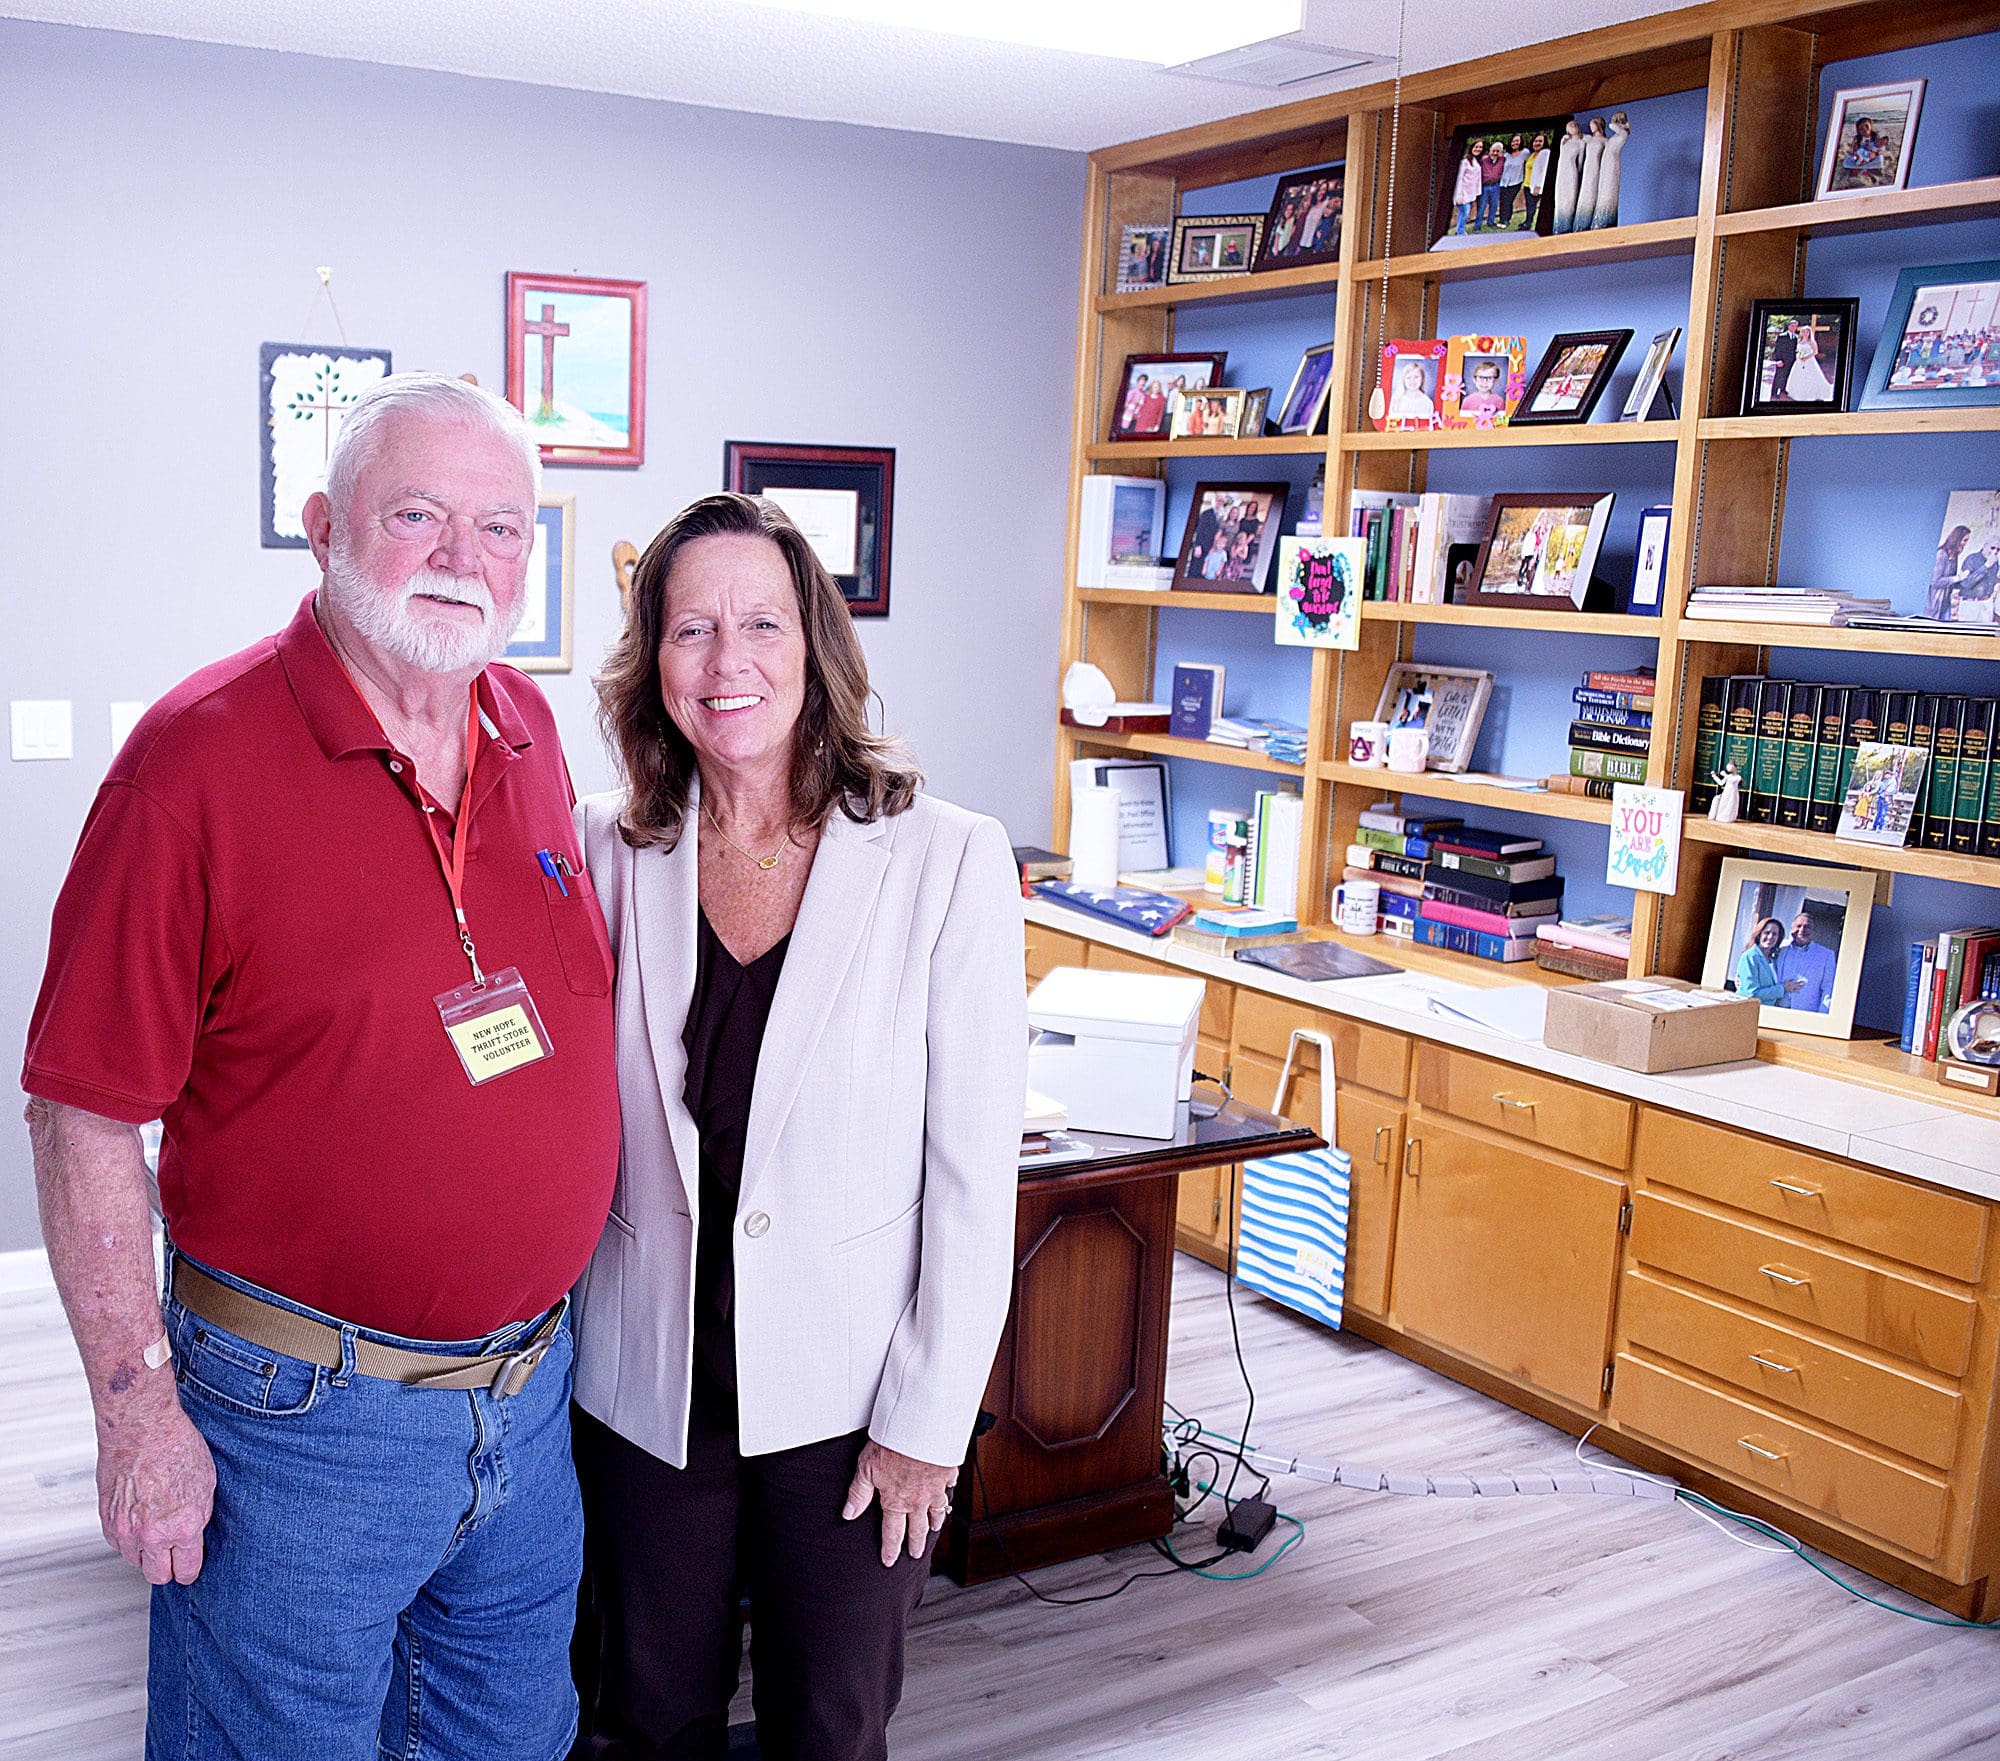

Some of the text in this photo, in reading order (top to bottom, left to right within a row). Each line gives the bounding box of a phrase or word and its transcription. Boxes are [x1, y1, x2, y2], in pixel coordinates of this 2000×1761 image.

[1582, 712, 1627, 725] DICTIONARY
[1592, 730, 1611, 743] Bible
[1612, 732, 1650, 750] Dictionary
[1607, 760, 1642, 775] BIBLE
[1621, 808, 1663, 836] YOU
[1630, 836, 1652, 852] ARE
[1611, 844, 1666, 879] Loved
[1950, 944, 1960, 954] 15
[471, 1026, 529, 1053] THRIFT STORE
[473, 1019, 516, 1040] NEW HOPE
[483, 1038, 531, 1061] VOLUNTEER
